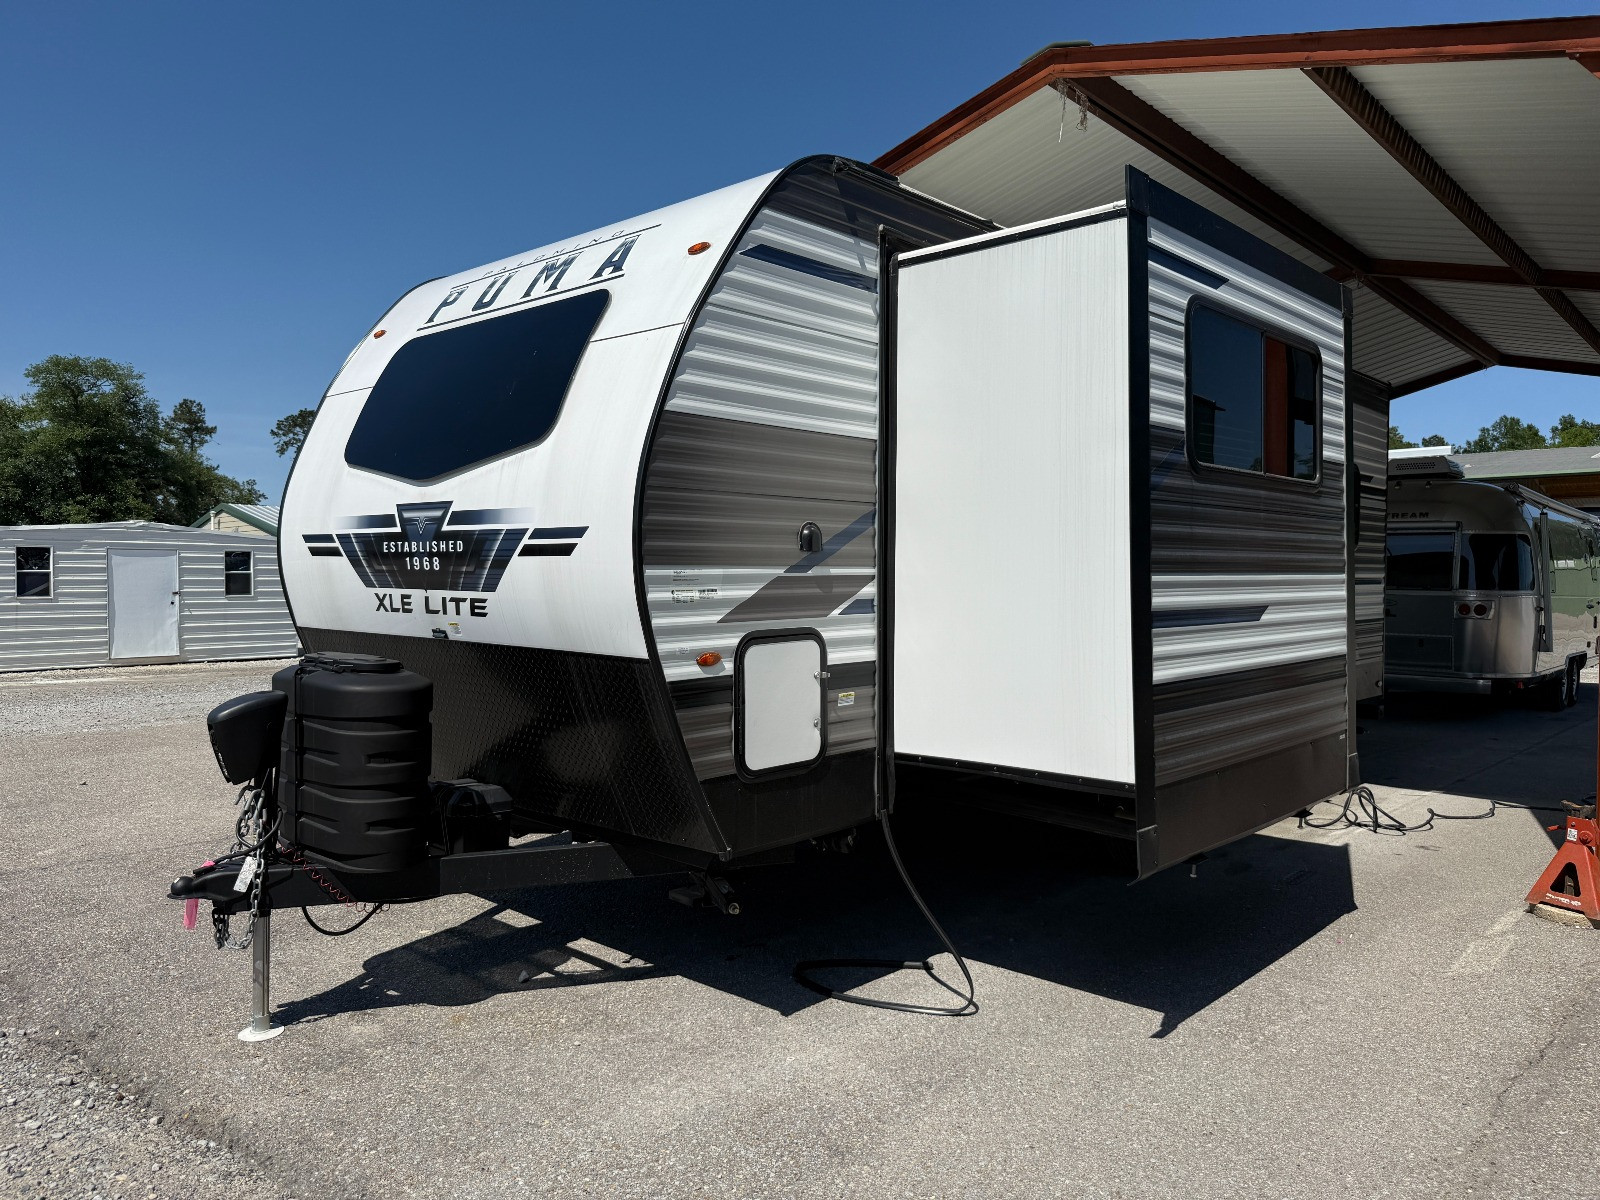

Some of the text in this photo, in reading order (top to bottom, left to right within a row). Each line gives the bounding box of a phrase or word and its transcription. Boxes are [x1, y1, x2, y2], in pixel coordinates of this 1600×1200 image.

[482, 229, 625, 278] PALOMINO
[424, 233, 642, 325] PUMA
[383, 540, 464, 553] ESTABLISHED
[405, 556, 441, 571] 1968
[374, 592, 489, 618] XLE LITE
